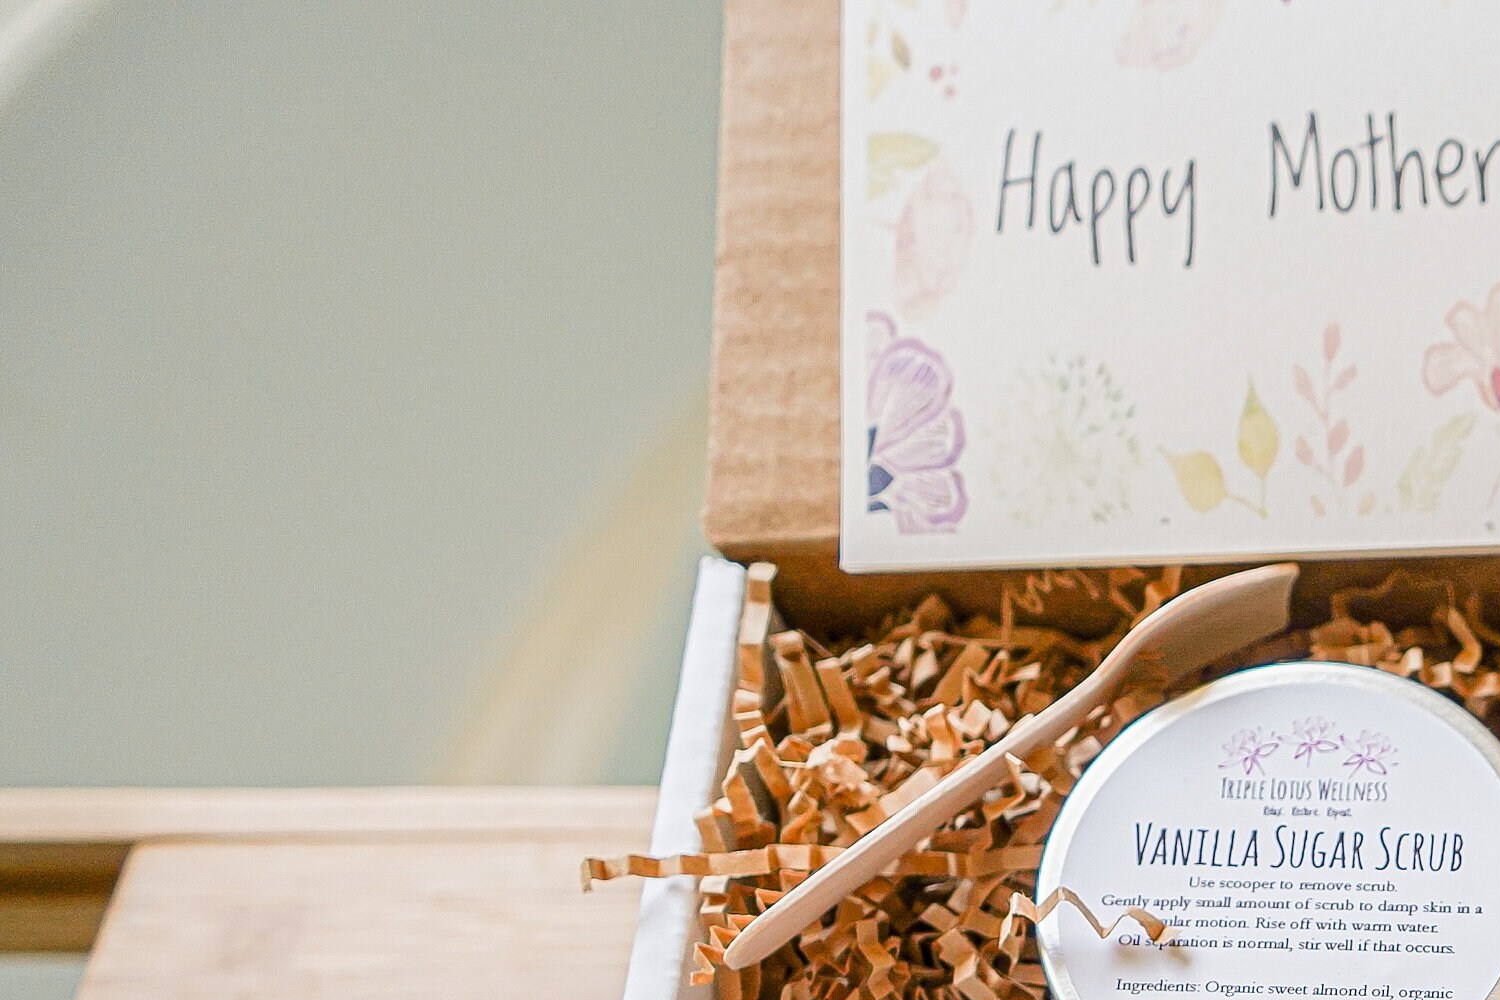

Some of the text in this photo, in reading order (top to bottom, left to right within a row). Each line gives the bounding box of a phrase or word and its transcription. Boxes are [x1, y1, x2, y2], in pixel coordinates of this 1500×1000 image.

[995, 128, 1198, 268] Happy
[1221, 776, 1388, 803] TRIPLE LOTUS WELLNESS
[1135, 822, 1464, 872] VANILLA SUGAR SCRUB
[1189, 876, 1399, 893] Use scooper to remove scrub.
[1101, 894, 1483, 916] Gently apply small amount of scrub to damp skin in a
[1195, 916, 1250, 929] motion.
[1255, 916, 1286, 930] Rise
[1290, 918, 1315, 930] off
[1315, 919, 1347, 932] with
[1352, 922, 1392, 933] warm
[1396, 923, 1438, 934] water.
[1118, 934, 1141, 946] Oil
[1222, 936, 1233, 948] is
[1237, 938, 1293, 952] normal,
[1298, 938, 1321, 952] stir
[1325, 940, 1353, 951] well
[1358, 939, 1372, 952] if
[1373, 940, 1402, 953] that
[1405, 943, 1456, 954] occurs.
[1115, 979, 1202, 995] Ingredients:
[1205, 980, 1264, 997] Organic
[1267, 985, 1308, 995] sweet
[1312, 983, 1367, 997] almond
[1371, 984, 1395, 1000] oil,
